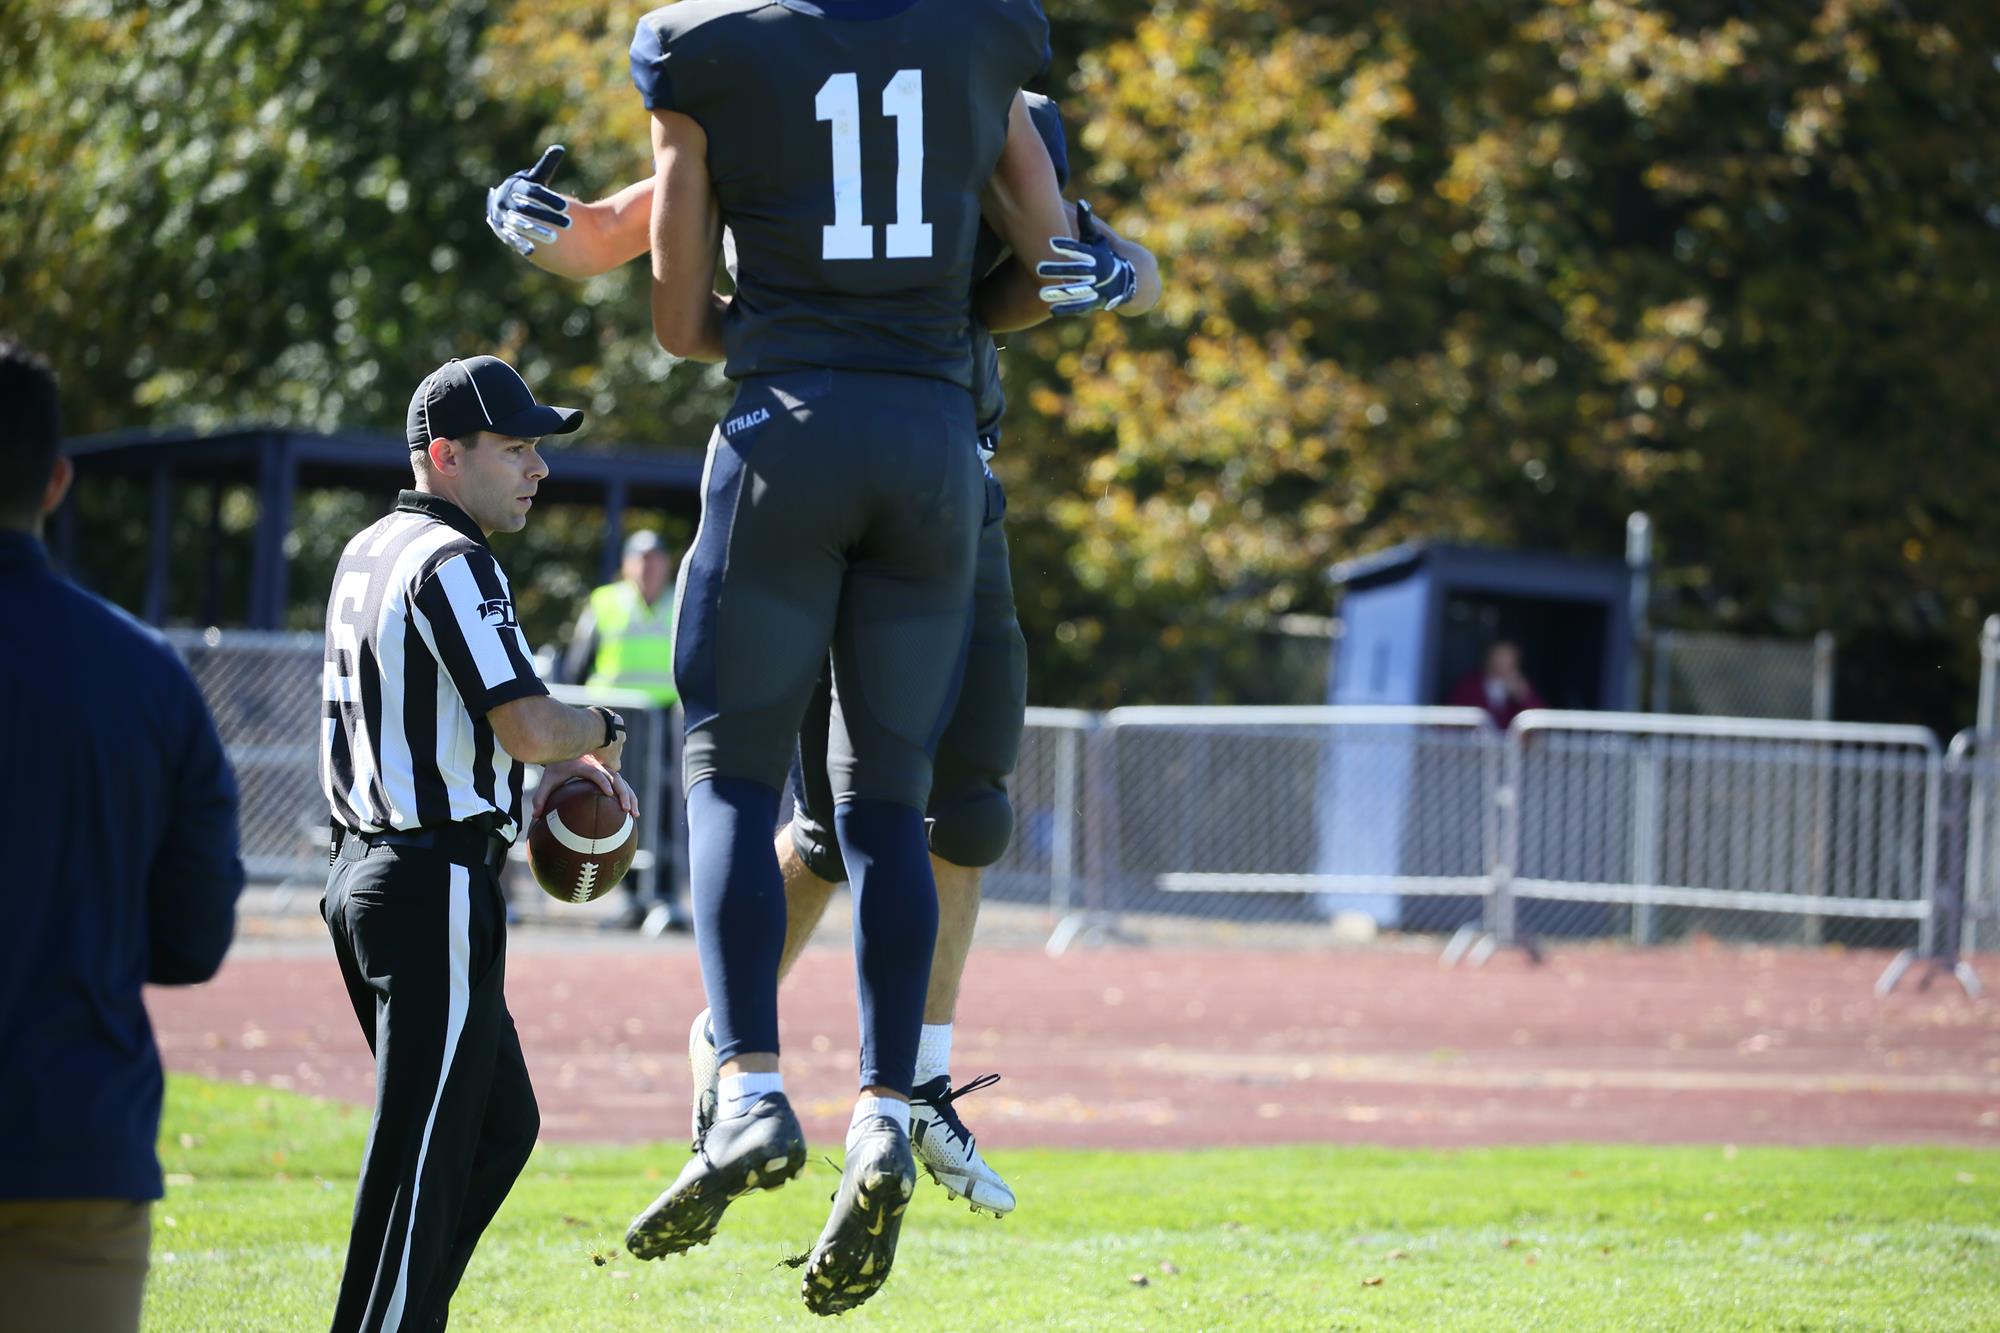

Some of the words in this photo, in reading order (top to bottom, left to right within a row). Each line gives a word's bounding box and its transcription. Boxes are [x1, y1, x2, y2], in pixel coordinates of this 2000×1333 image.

[815, 69, 933, 260] 11
[727, 407, 770, 436] ITHACA
[476, 600, 518, 627] 150
